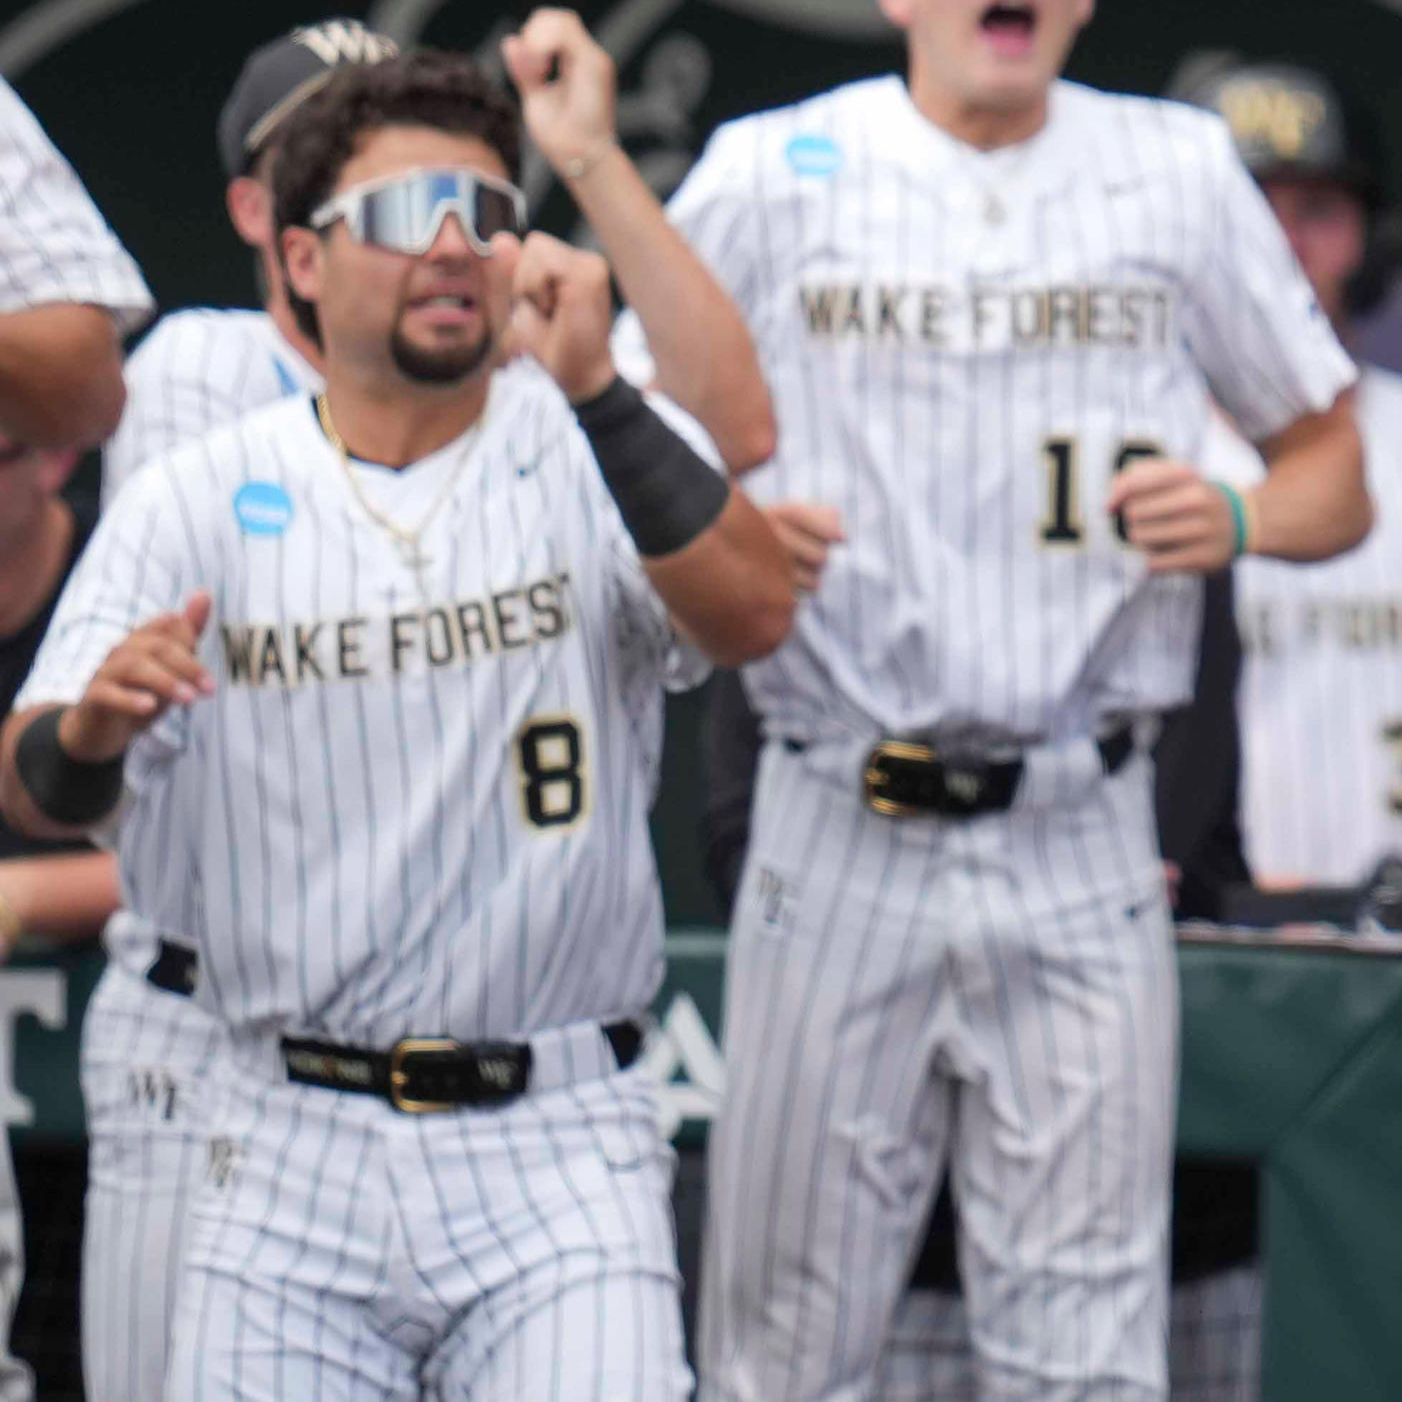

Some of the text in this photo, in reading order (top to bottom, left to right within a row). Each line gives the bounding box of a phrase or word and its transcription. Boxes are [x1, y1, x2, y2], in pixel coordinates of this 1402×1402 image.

[798, 280, 1174, 348] WAKE FOREST
[220, 616, 371, 688] WAKE
[516, 713, 589, 834] 8
